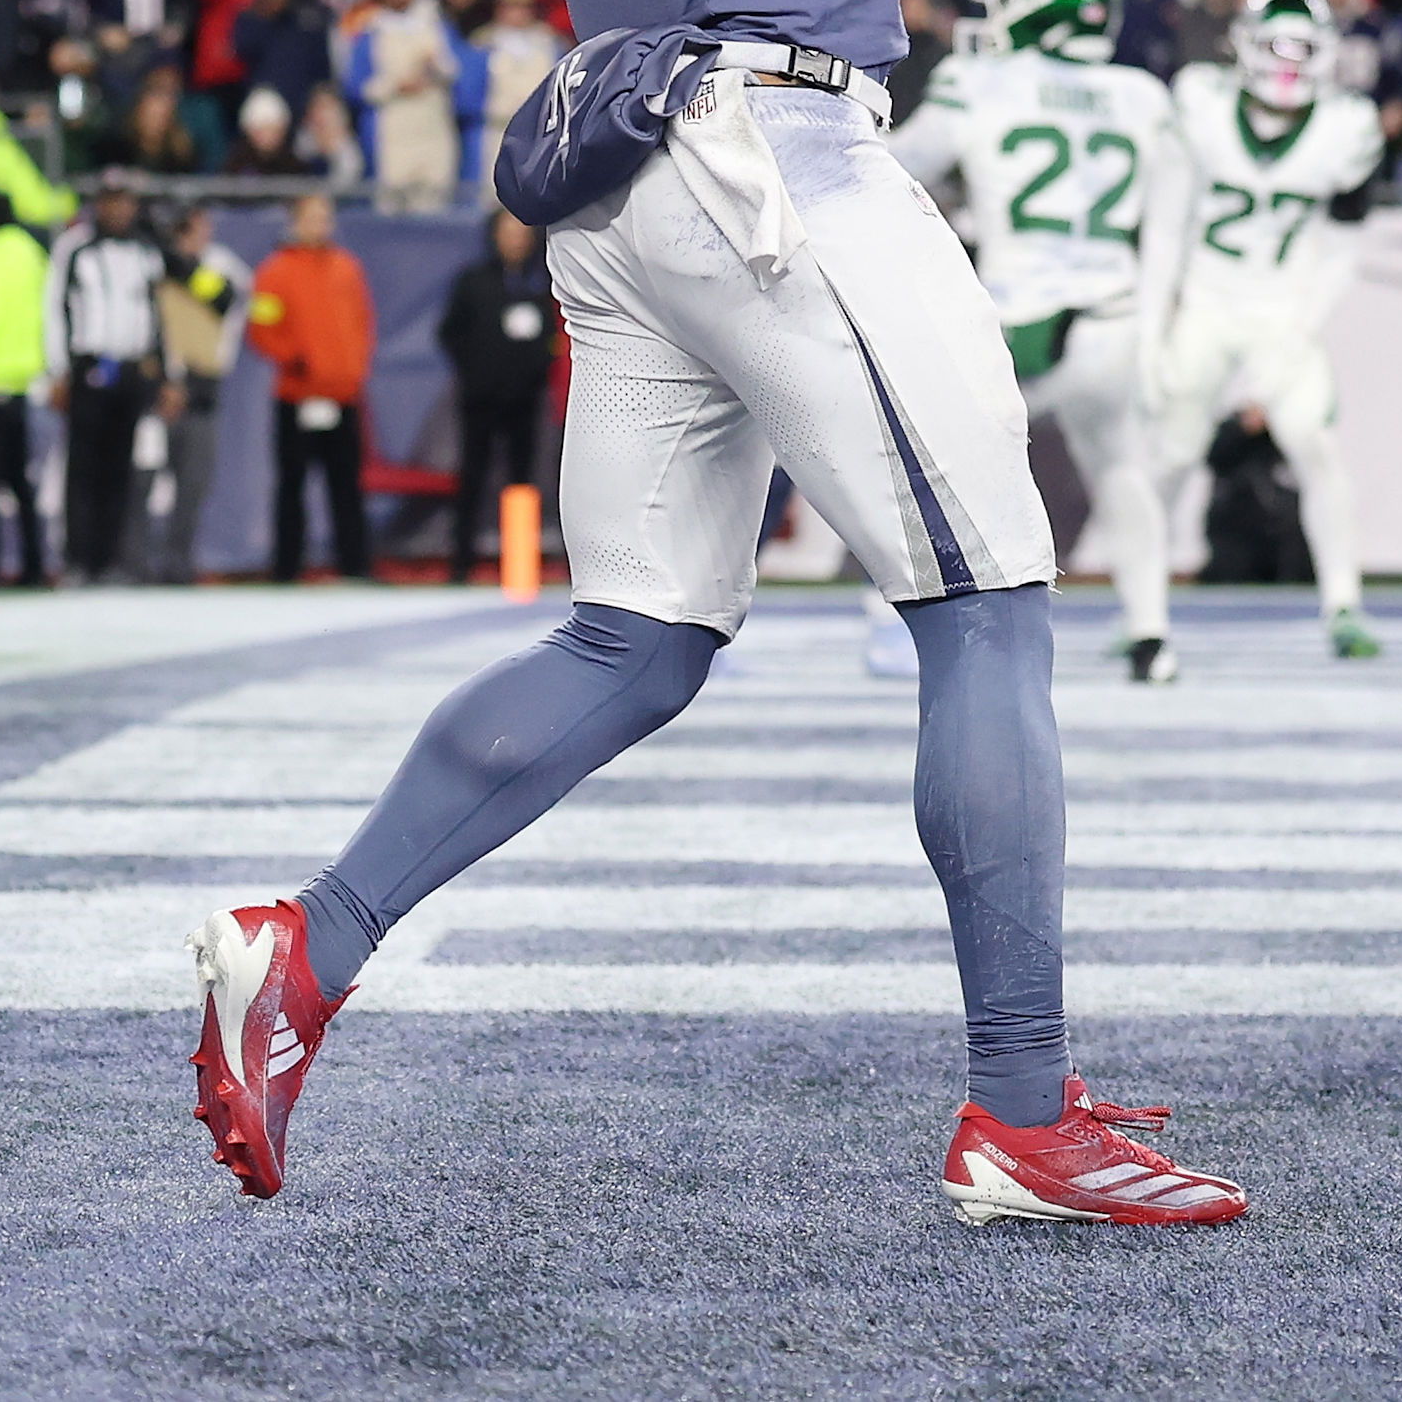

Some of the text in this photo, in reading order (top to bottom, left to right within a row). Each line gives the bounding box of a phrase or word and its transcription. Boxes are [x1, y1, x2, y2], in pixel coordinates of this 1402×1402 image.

[685, 95, 713, 121] NFL
[1001, 125, 1138, 245] 22
[1204, 181, 1317, 266] 27
